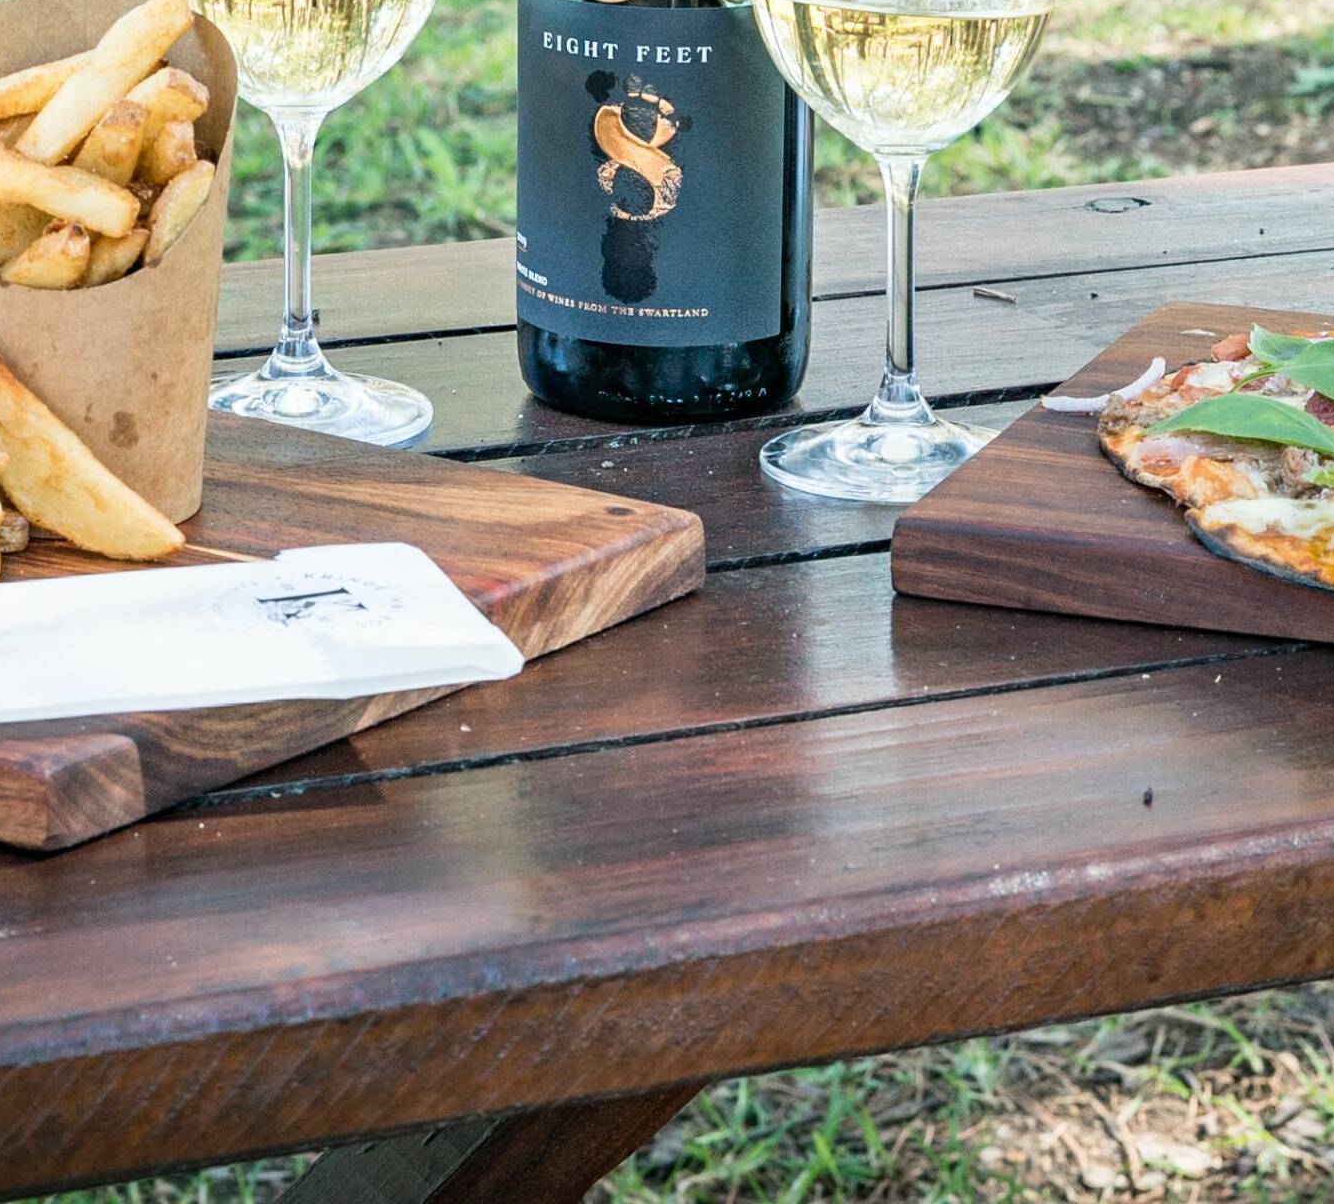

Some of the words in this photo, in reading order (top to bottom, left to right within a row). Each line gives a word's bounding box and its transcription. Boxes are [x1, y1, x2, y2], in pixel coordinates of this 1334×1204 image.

[543, 32, 618, 59] EIGHT
[636, 46, 713, 63] FEET
[528, 270, 548, 286] BLEND
[536, 290, 546, 300] OF
[547, 293, 575, 308] WINES
[578, 300, 607, 314] FROM
[611, 306, 634, 316] THE
[638, 307, 709, 318] SWARTLAND
